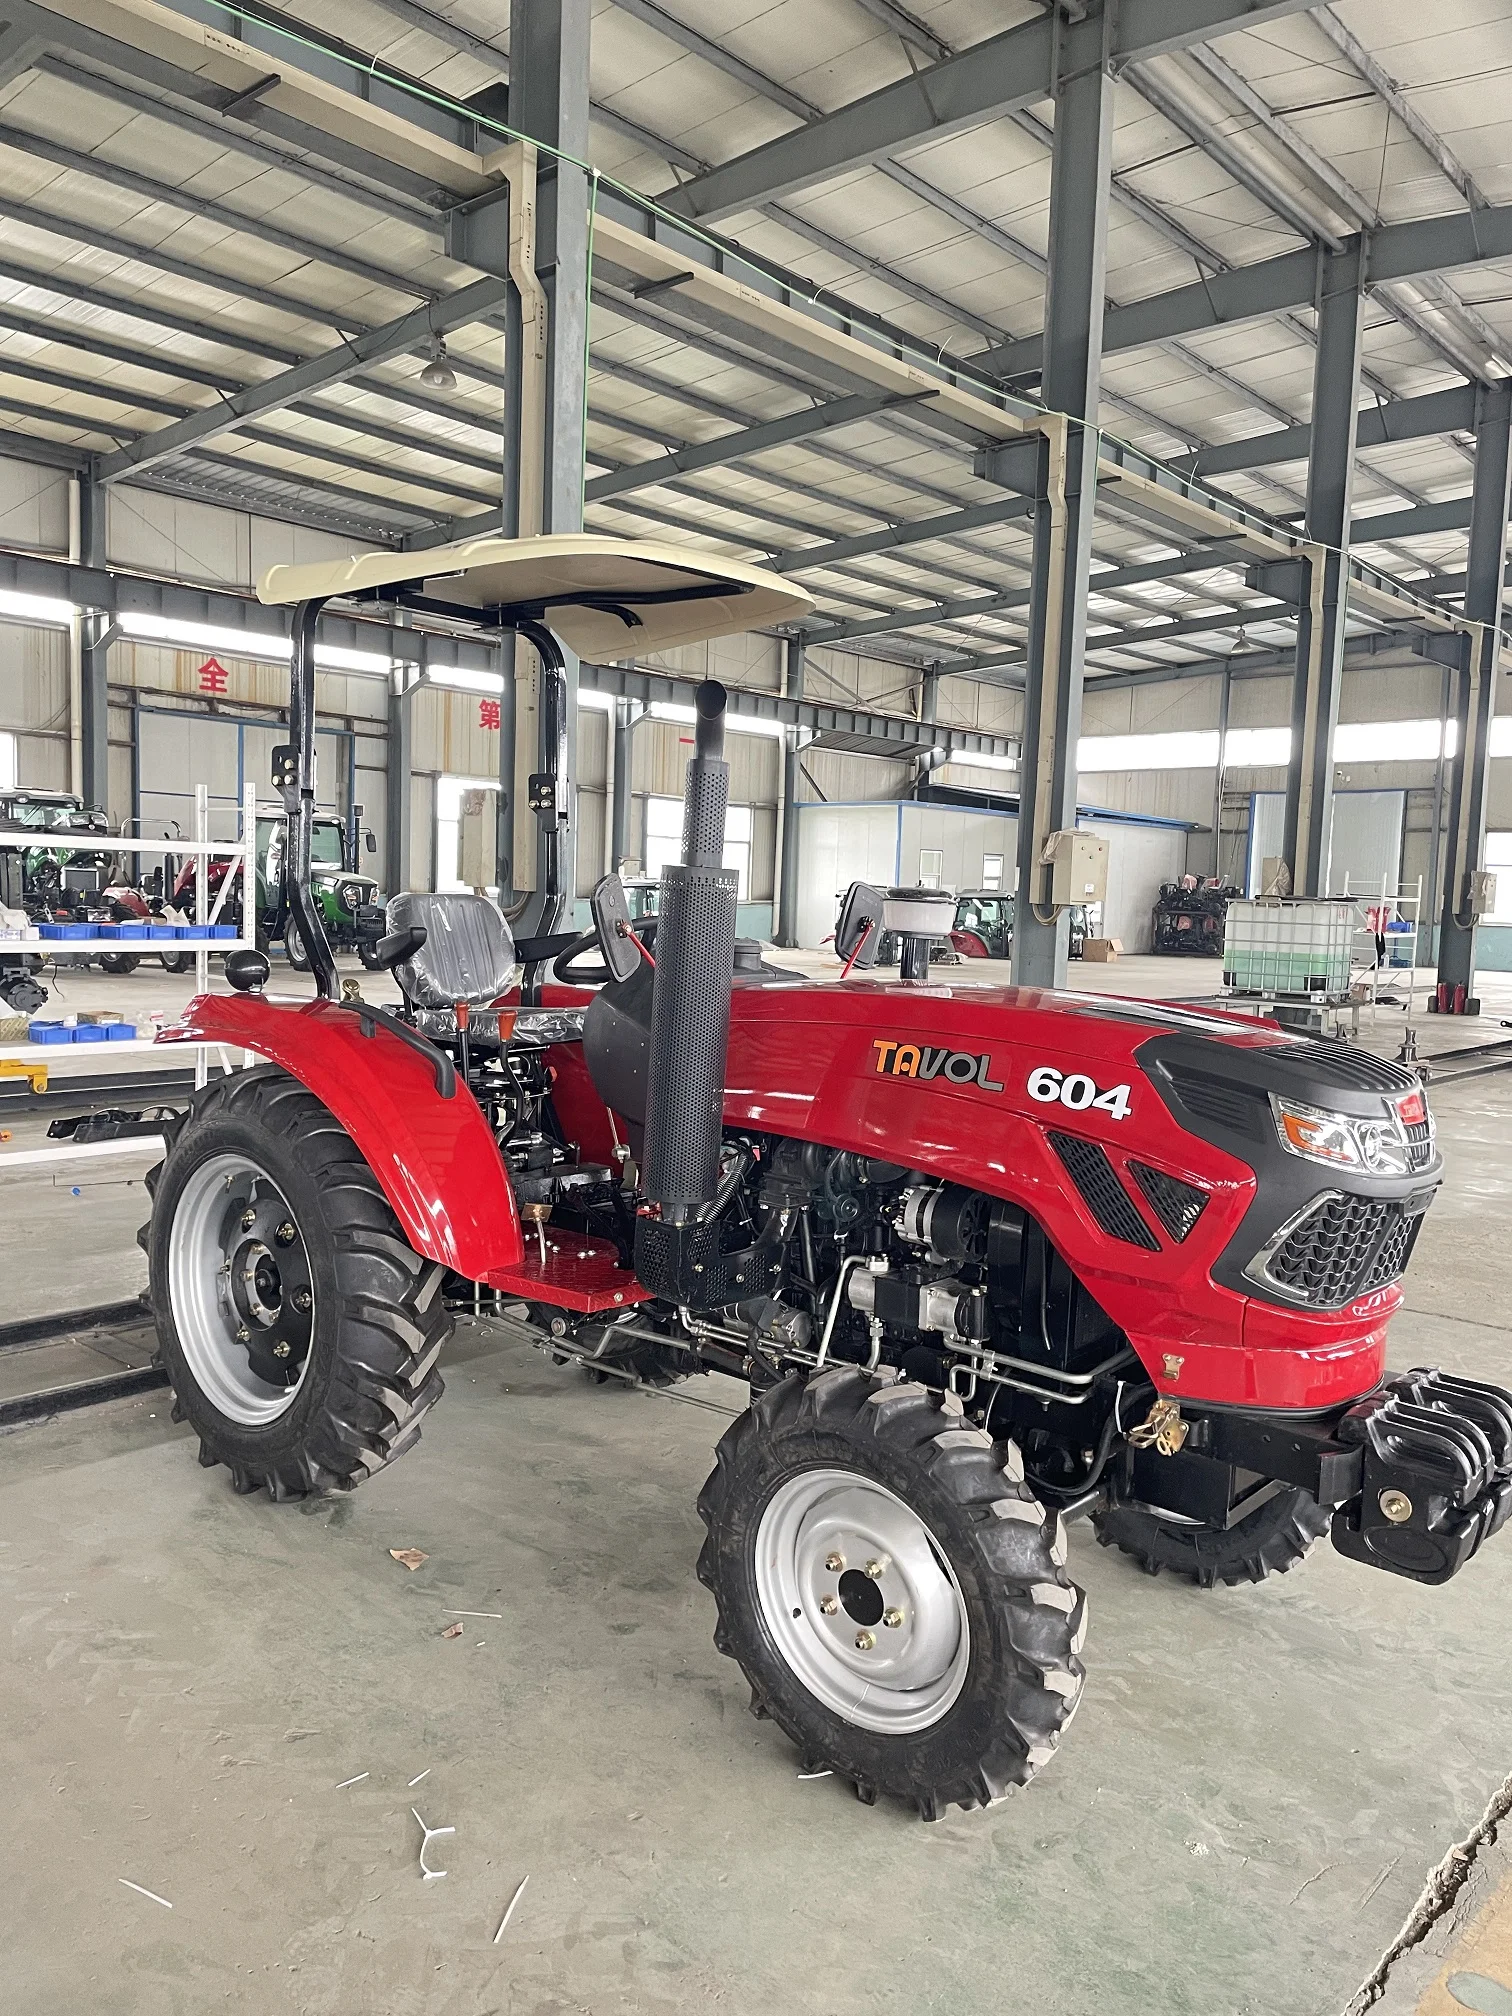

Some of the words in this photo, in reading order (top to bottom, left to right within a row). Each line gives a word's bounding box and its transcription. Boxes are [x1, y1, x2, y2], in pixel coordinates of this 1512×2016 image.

[198, 657, 229, 692] 全
[479, 699, 501, 730] 第
[873, 1039, 1005, 1092] TAVOL
[1026, 1066, 1133, 1121] 604
